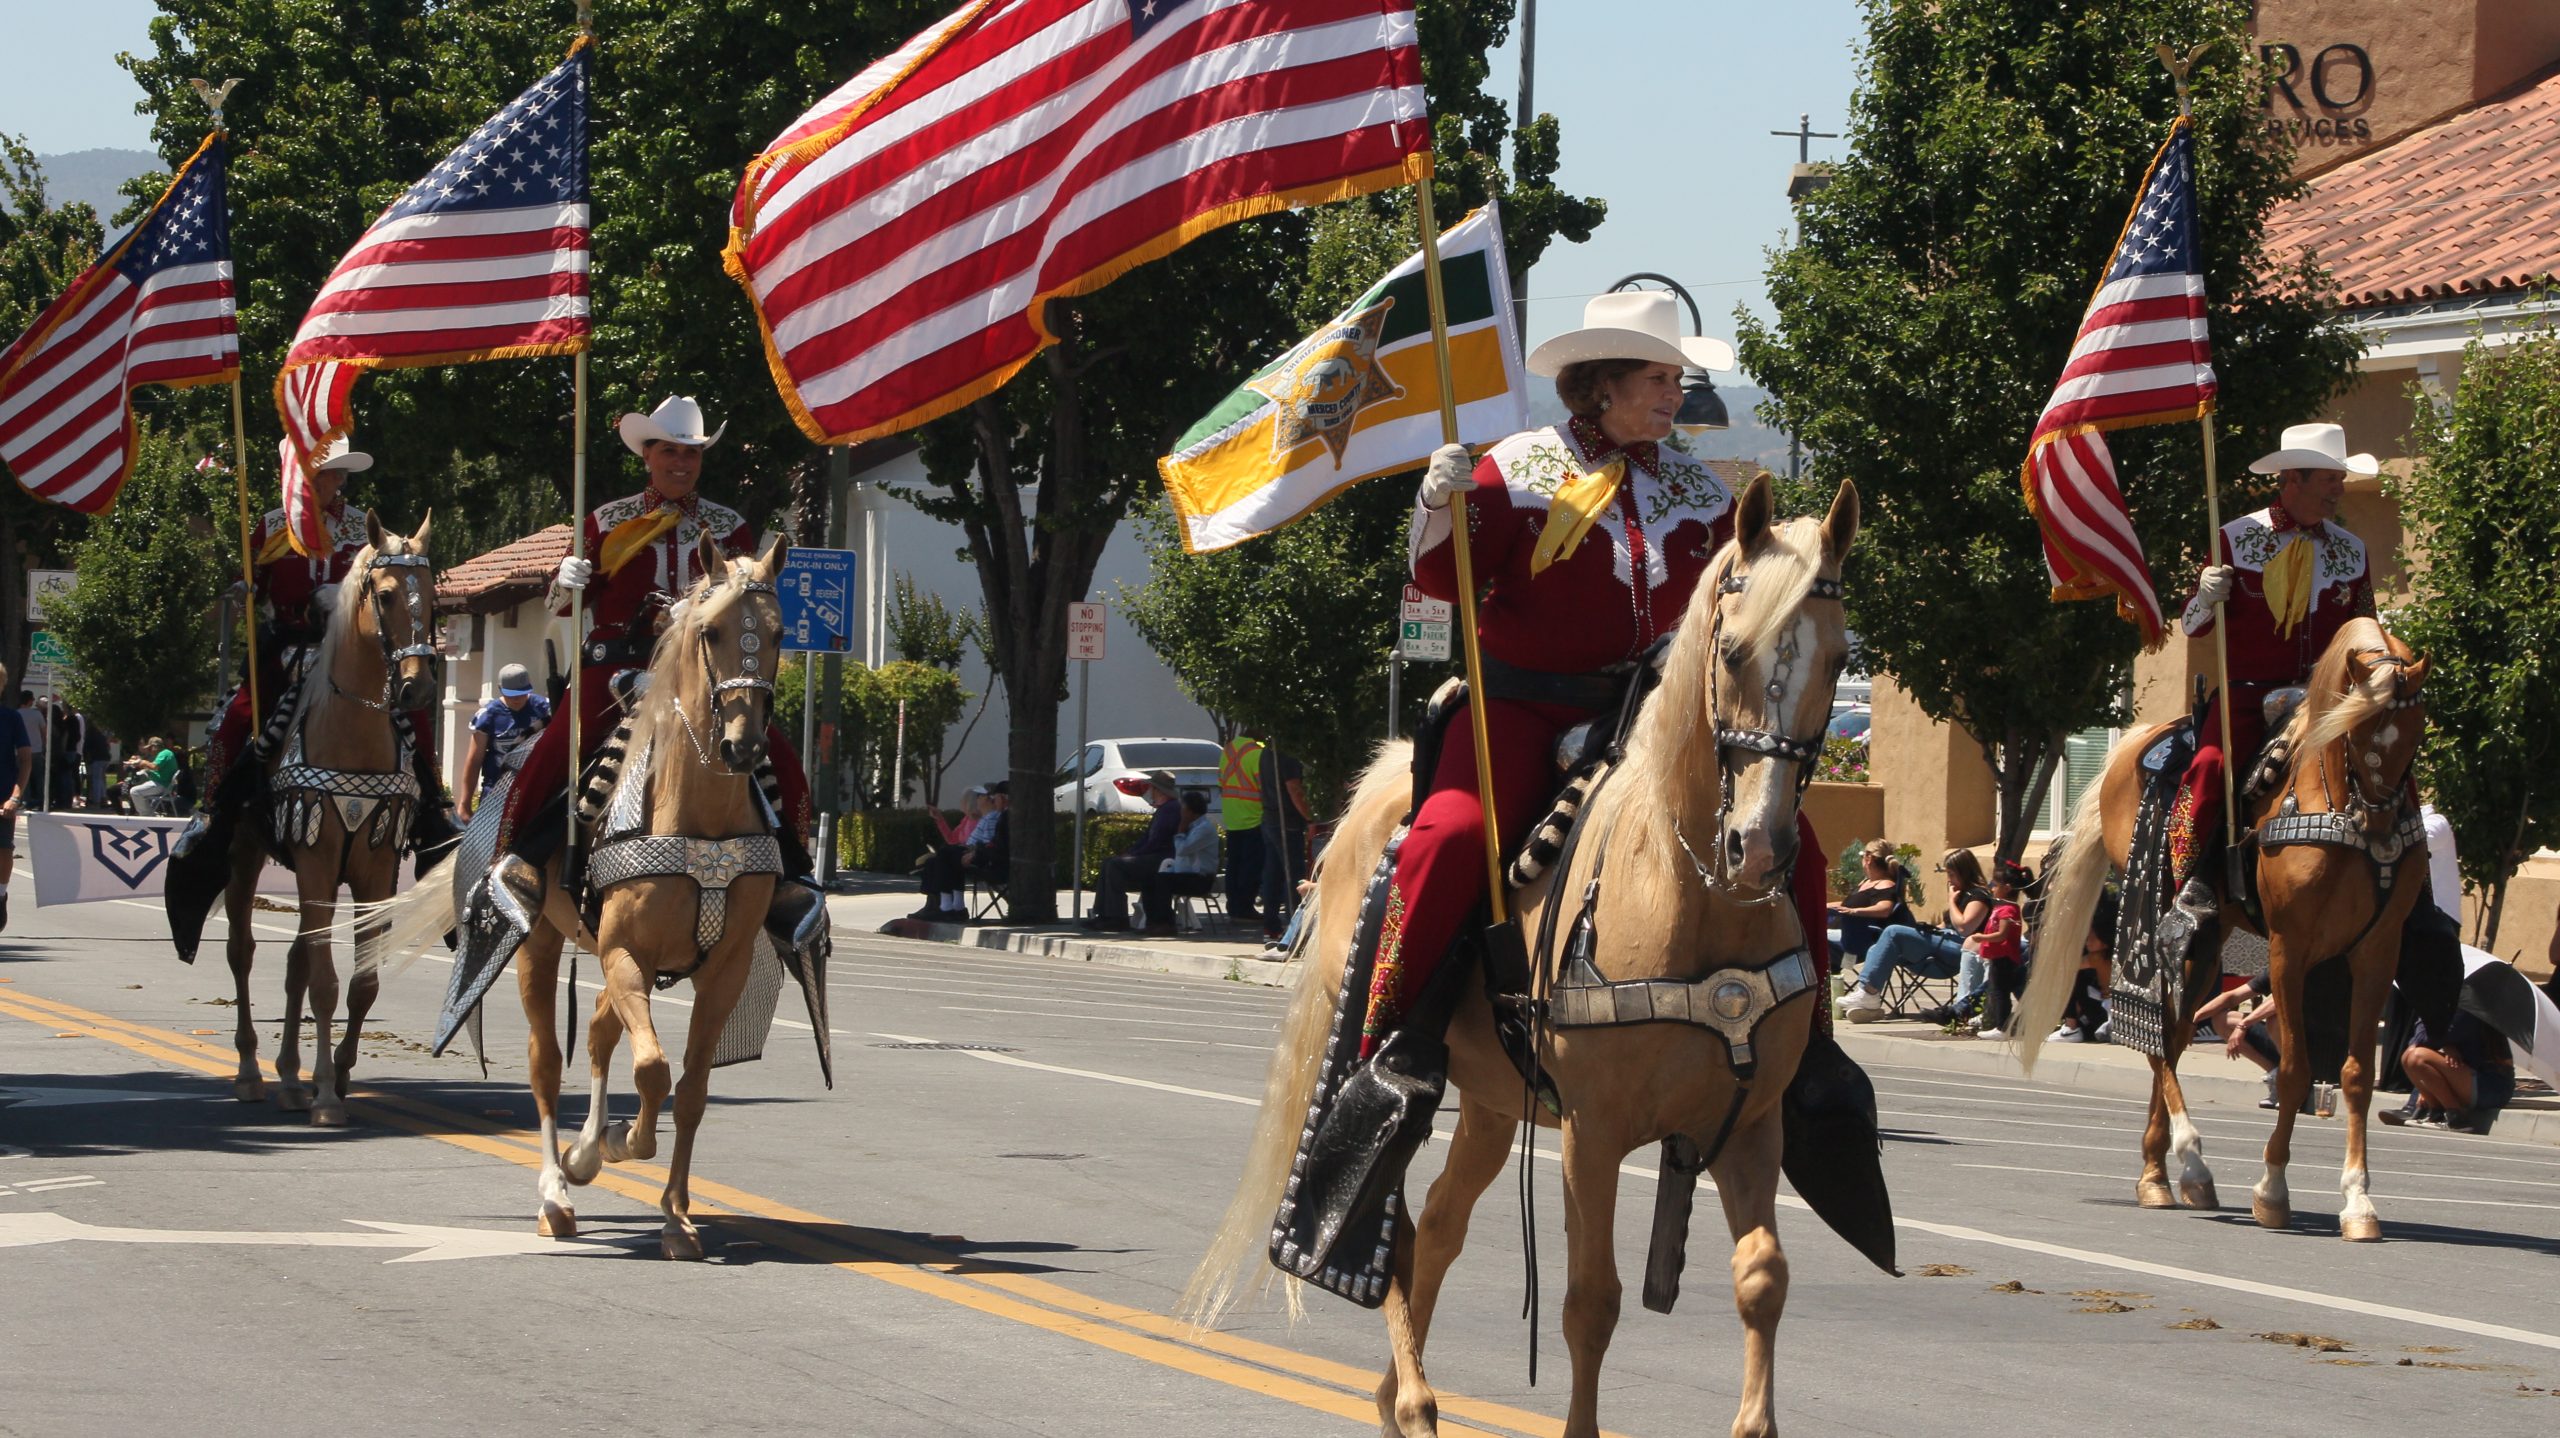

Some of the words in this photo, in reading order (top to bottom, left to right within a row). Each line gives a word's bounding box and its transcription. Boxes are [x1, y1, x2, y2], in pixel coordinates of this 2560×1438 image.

[1306, 403, 1338, 414] MERCED
[783, 560, 822, 570] BACK-IN
[824, 562, 849, 571] ONLY
[1407, 587, 1420, 601] NO
[1081, 609, 1094, 620] NO
[1071, 622, 1104, 633] STOPPING
[1408, 624, 1417, 638] 3
[1080, 635, 1094, 643] ANY
[1423, 631, 1447, 641] PARKING
[1079, 645, 1095, 654] TIME
